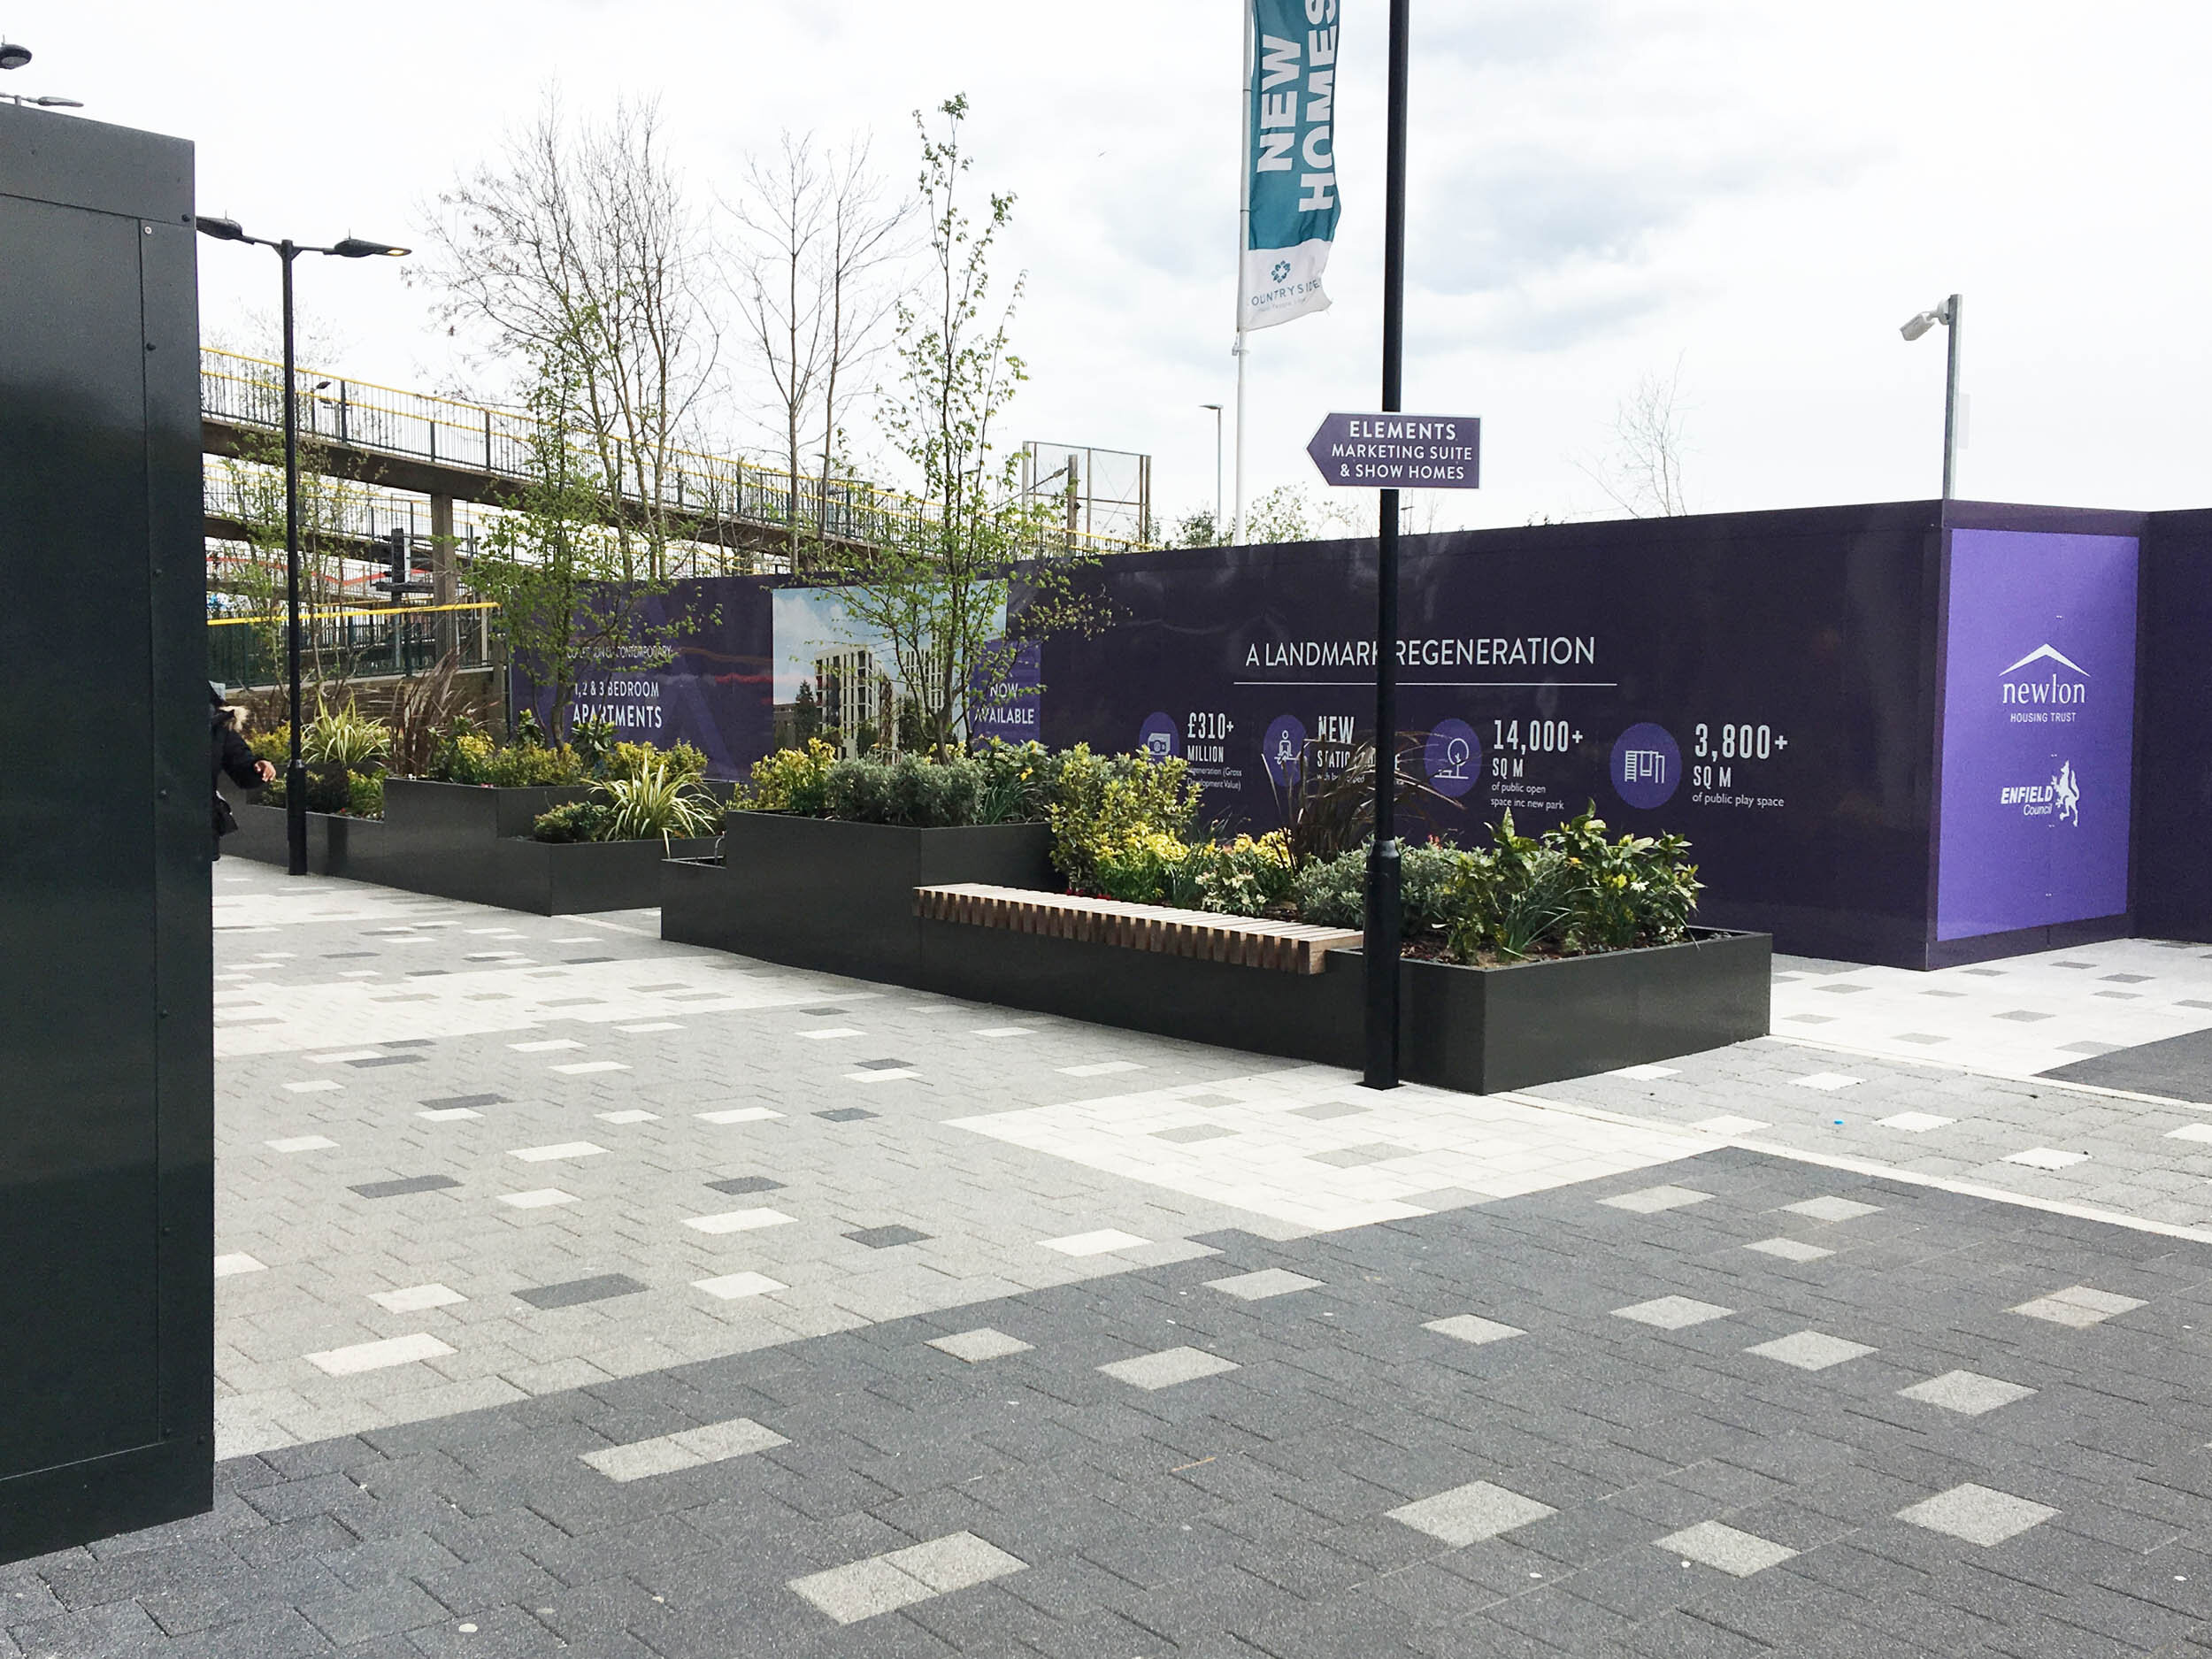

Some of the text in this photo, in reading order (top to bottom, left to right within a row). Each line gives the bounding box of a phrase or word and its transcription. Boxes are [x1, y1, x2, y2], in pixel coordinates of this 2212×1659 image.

[1256, 34, 1302, 173] NEW
[1299, 0, 1338, 212] HOMES
[1349, 420, 1456, 441] ELEMENTS
[1332, 444, 1472, 461] MARKETING SUITE
[1340, 464, 1464, 480] & SHOW HOMES
[1245, 643, 1260, 666] A
[590, 680, 596, 696] &
[607, 680, 659, 697] BEDROOM
[990, 683, 1018, 698] NOW
[2002, 673, 2085, 704] newlon
[572, 703, 662, 728] APARTMENTS
[974, 708, 1034, 725] AVAILABLE
[1187, 711, 1234, 740] £310+
[2010, 711, 2077, 723] HOUSING TRUST
[1317, 716, 1355, 744] NEW
[1494, 719, 1584, 756] 14,000+
[1694, 723, 1788, 763] 3,800+
[1187, 745, 1224, 763] MILLION
[1492, 757, 1524, 780] SQ M
[1693, 765, 1732, 790] SQ M
[1491, 781, 1547, 796] of public open
[2001, 786, 2054, 805] ENFIELD
[1490, 798, 1512, 808] space
[1514, 798, 1525, 808] inc
[1546, 800, 1564, 811] park
[1692, 791, 1785, 810] of public play space
[2023, 803, 2053, 816] Council
